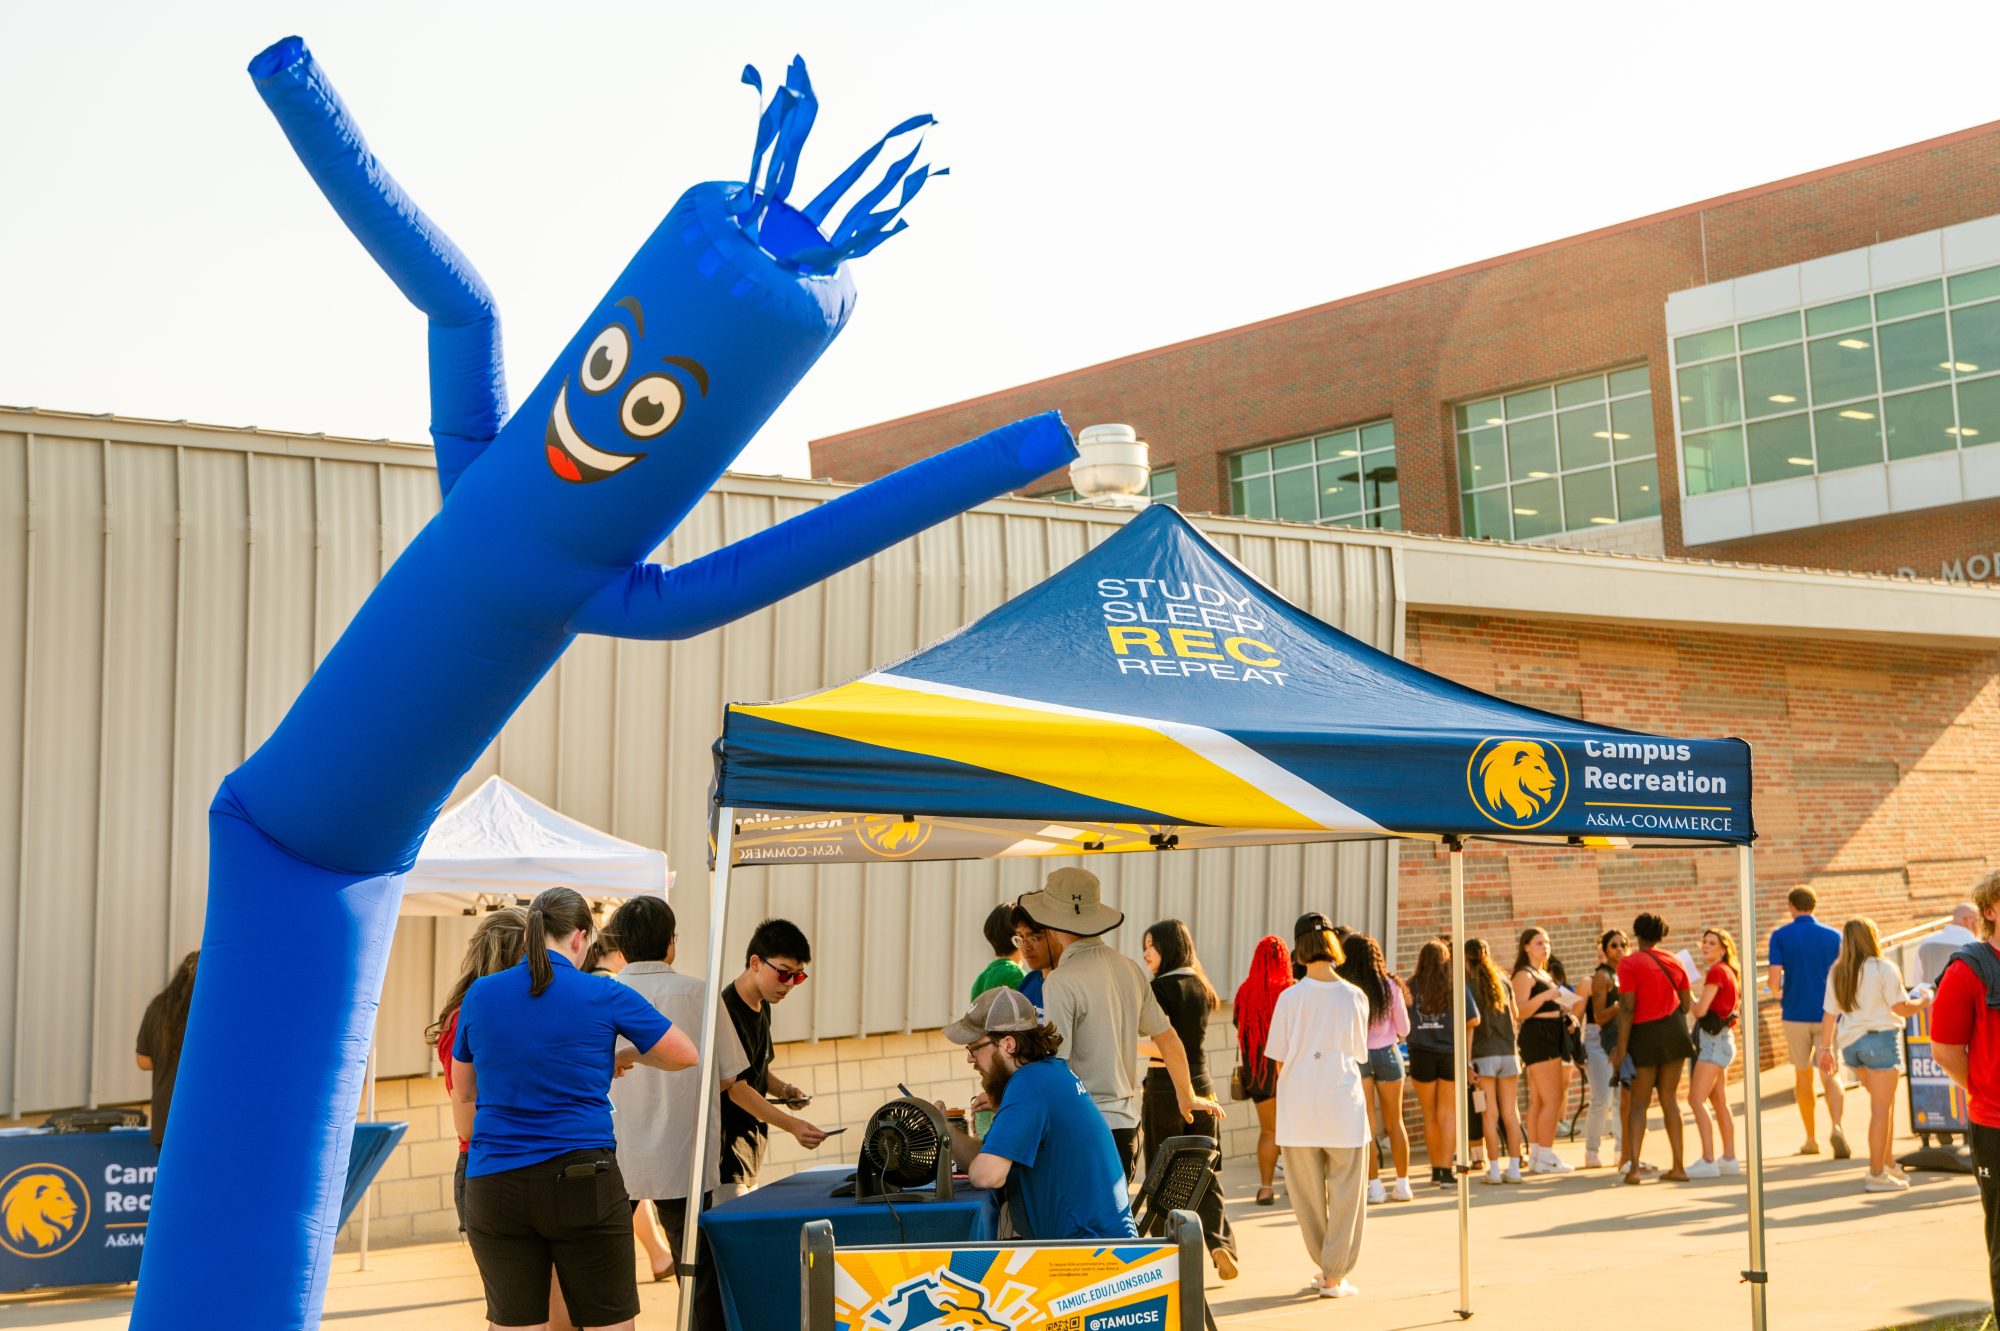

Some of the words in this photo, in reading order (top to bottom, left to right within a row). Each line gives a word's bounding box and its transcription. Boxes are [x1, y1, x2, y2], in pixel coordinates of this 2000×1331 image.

[1097, 578, 1251, 613] STUDY
[1102, 601, 1265, 634] SLEEP
[1107, 625, 1282, 668] REC
[1117, 658, 1289, 687] REPEAT
[1584, 739, 1691, 765] Campus
[1584, 766, 1727, 794] Recreation
[1585, 813, 1733, 832] A&M-COMMERCE
[1056, 1268, 1163, 1312] TAMUC.EDU/LIONSROAR
[1089, 1310, 1159, 1331] @TAMUCSE
